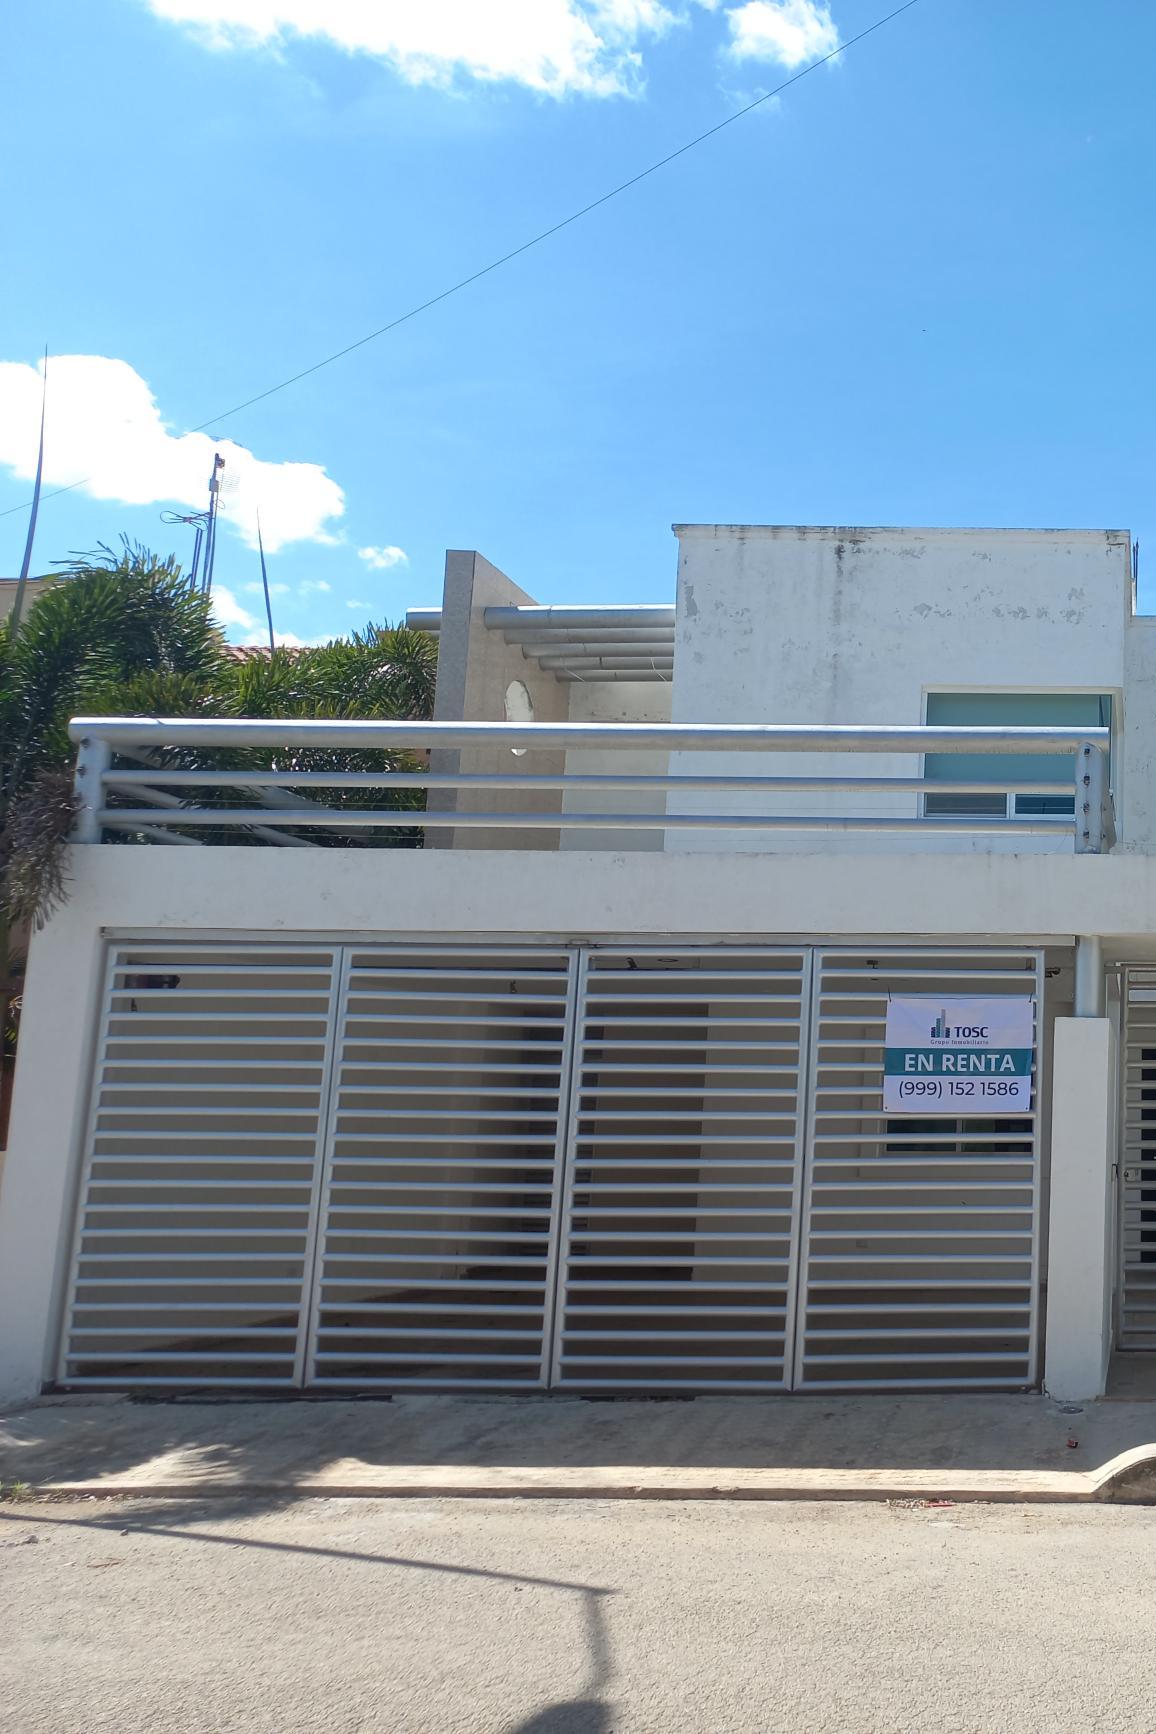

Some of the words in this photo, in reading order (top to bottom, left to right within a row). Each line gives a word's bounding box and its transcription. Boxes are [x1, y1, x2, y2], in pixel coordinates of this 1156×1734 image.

[954, 1026, 989, 1038] TOSC
[904, 1053, 934, 1072] EN
[942, 1053, 1016, 1072] RENTA
[898, 1081, 943, 1099] (999)
[948, 1081, 975, 1096] 152
[980, 1081, 1019, 1096] 1586
